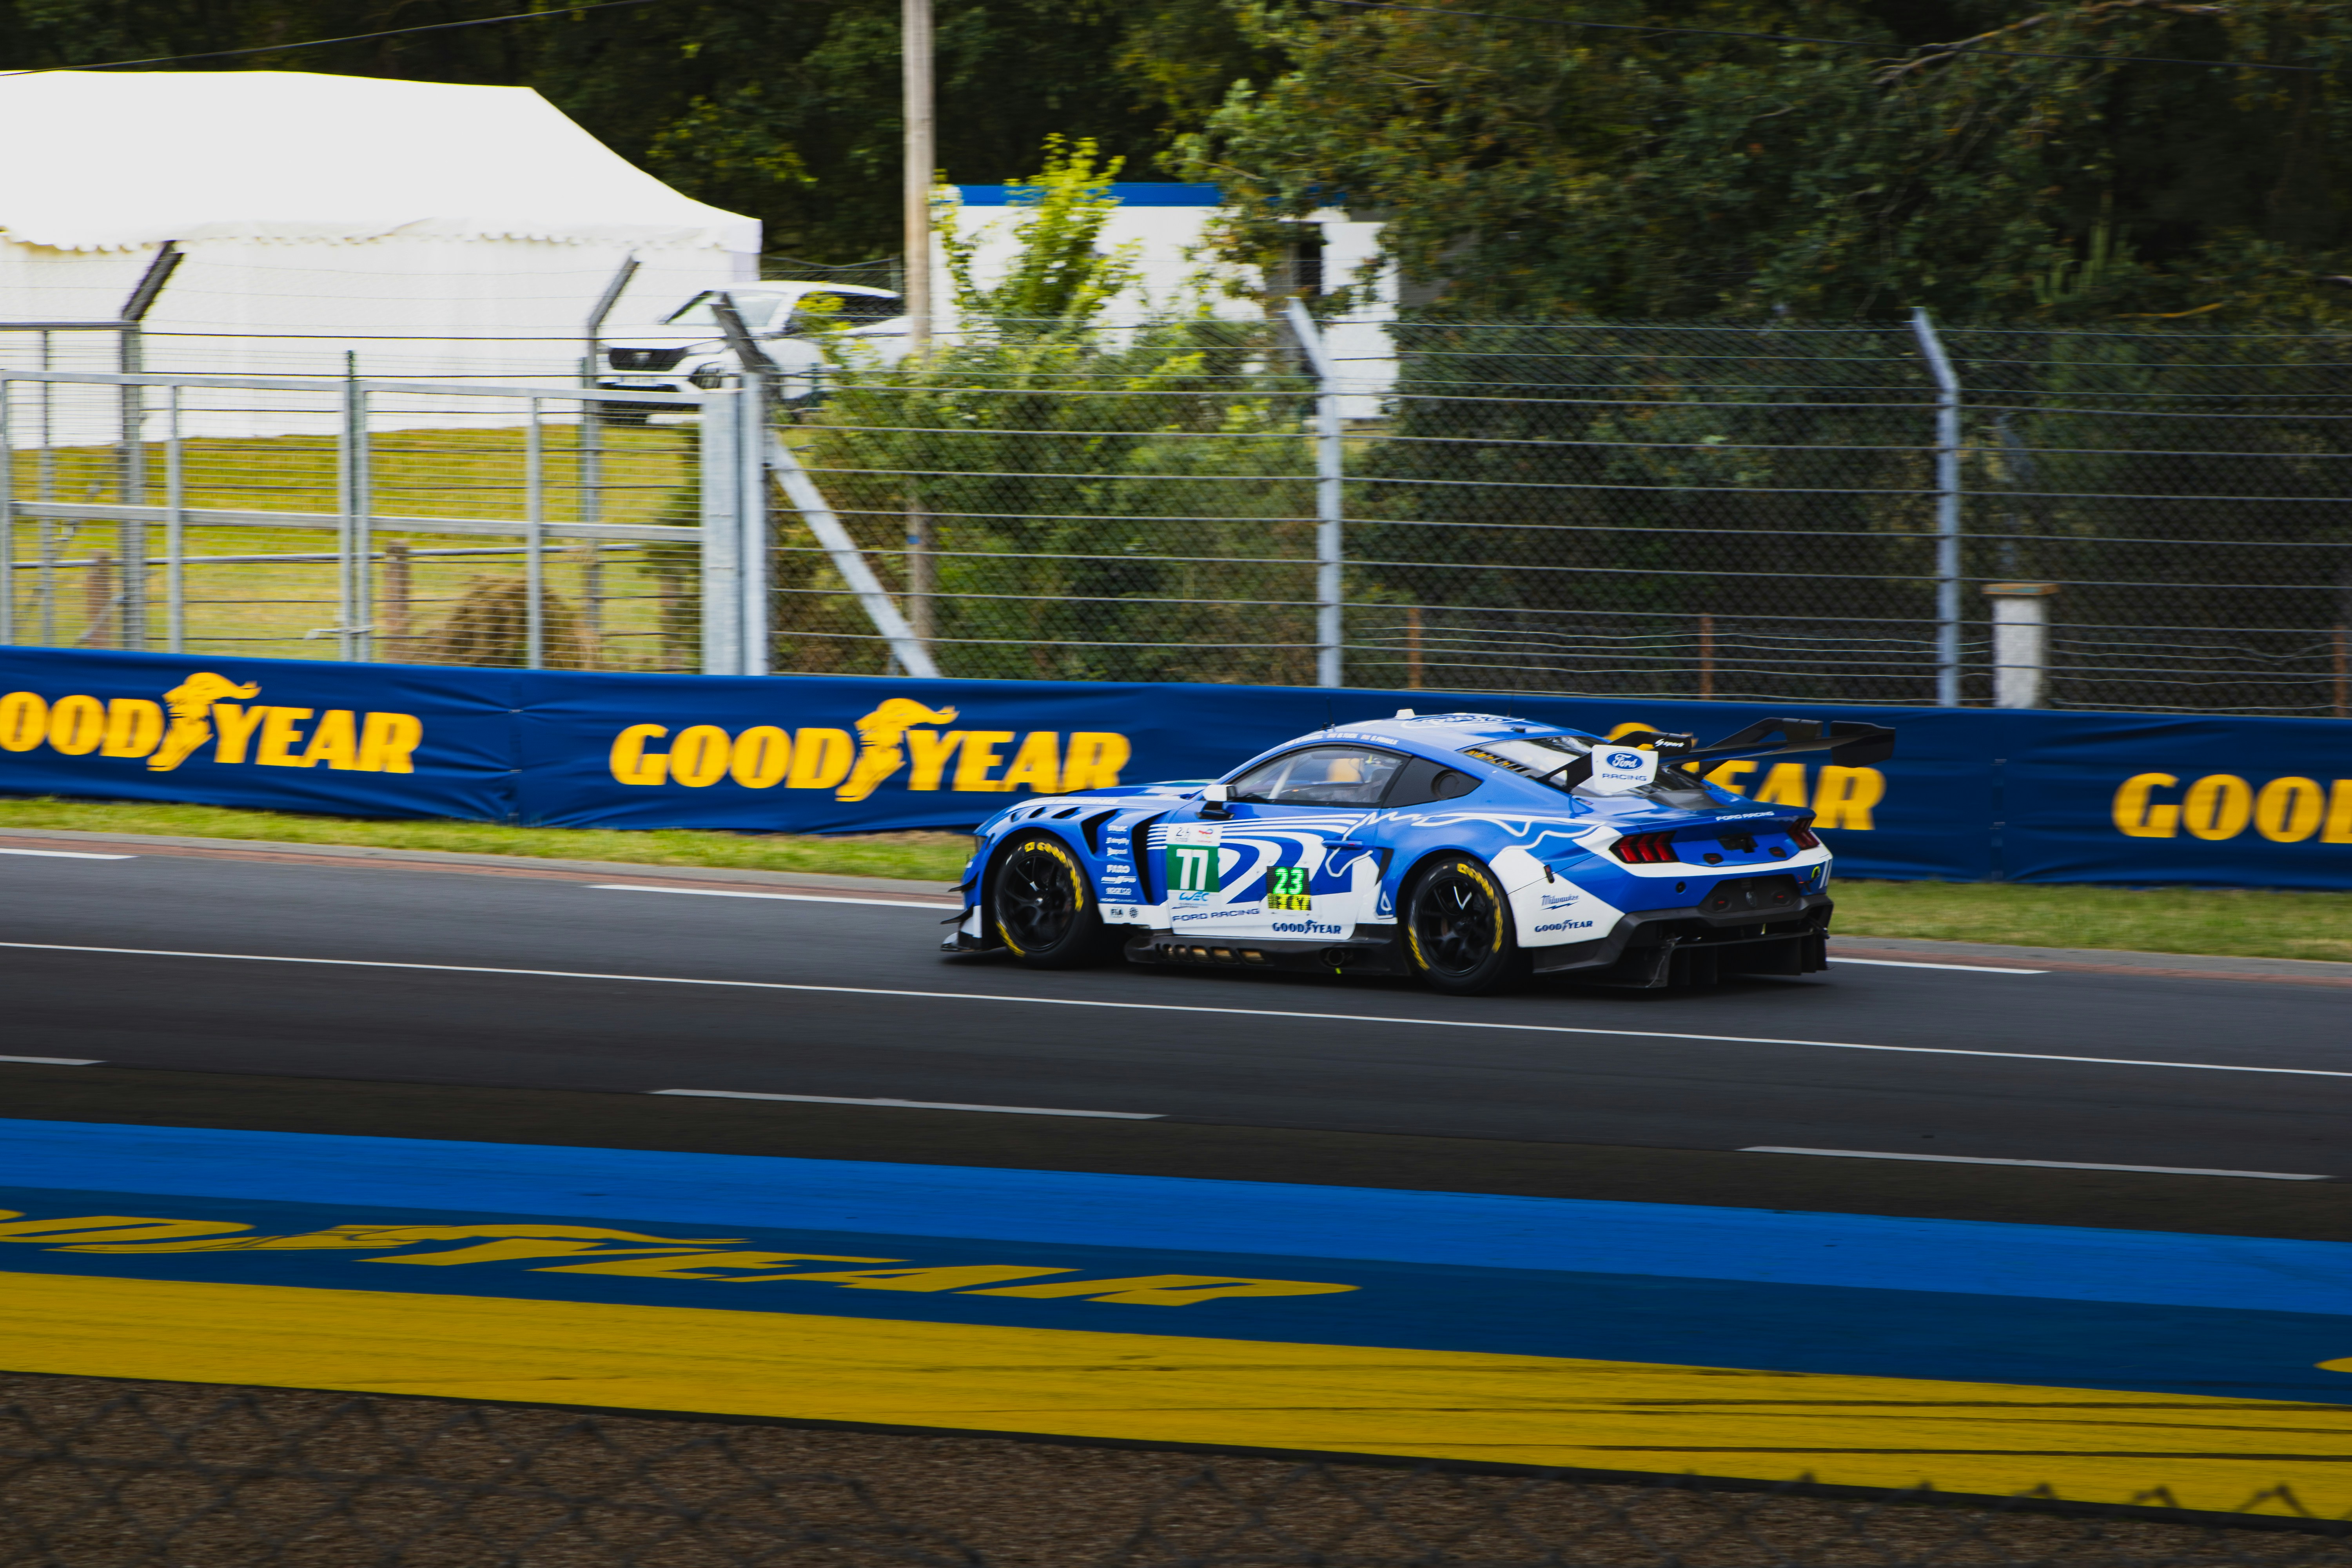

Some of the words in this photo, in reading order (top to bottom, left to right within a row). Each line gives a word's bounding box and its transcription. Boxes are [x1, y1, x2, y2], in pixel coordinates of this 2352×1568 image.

[609, 722, 1131, 793] GOODYEAR
[1612, 754, 1638, 768] Ford
[1681, 760, 1887, 830] EAR
[1272, 867, 1304, 895] 23
[1179, 891, 1210, 901] WEC
[1172, 913, 1208, 922] FORD
[1211, 908, 1260, 918] RACING
[1272, 920, 1342, 935] GOODYEAR
[1535, 920, 1593, 932] GOODYEAR
